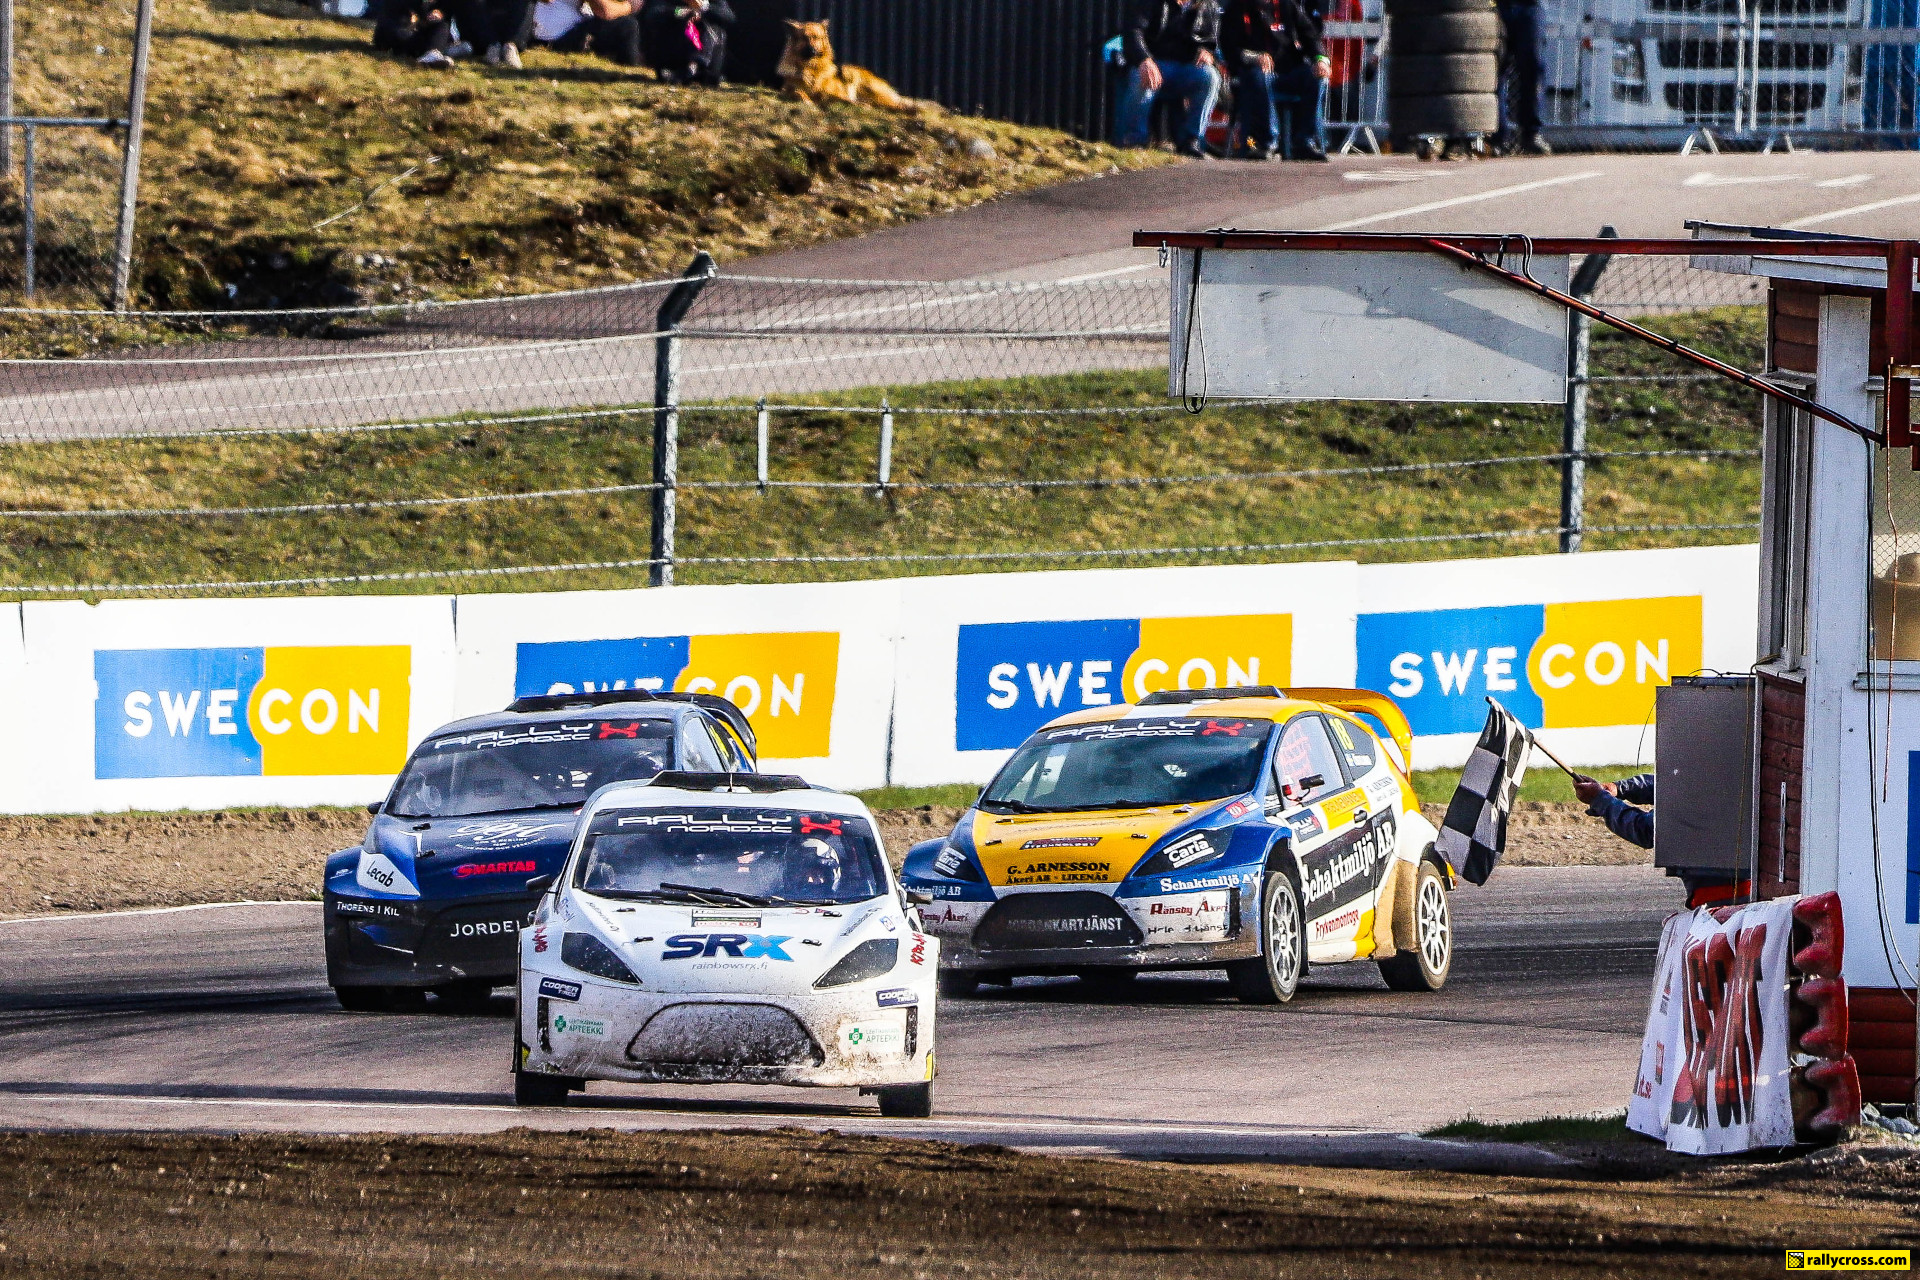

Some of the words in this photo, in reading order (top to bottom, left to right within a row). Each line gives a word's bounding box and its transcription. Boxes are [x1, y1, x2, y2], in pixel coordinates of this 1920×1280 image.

[1388, 638, 1669, 698] SWECON
[123, 687, 380, 738] SWECON
[618, 814, 792, 828] RALLY
[667, 825, 793, 834] NORDIC
[1007, 865, 1022, 876] G.
[1024, 862, 1111, 875] ARNESSON
[1300, 832, 1376, 907] Schaktmiljö
[1375, 821, 1395, 859] AB
[366, 860, 395, 888] Lecab
[1160, 874, 1240, 892] Schaktmiljö
[946, 886, 962, 896] AB
[384, 905, 400, 917] KIL
[661, 933, 796, 963] SRX
[691, 961, 769, 972] rainbowsrx.fi
[542, 980, 579, 992] COOPER
